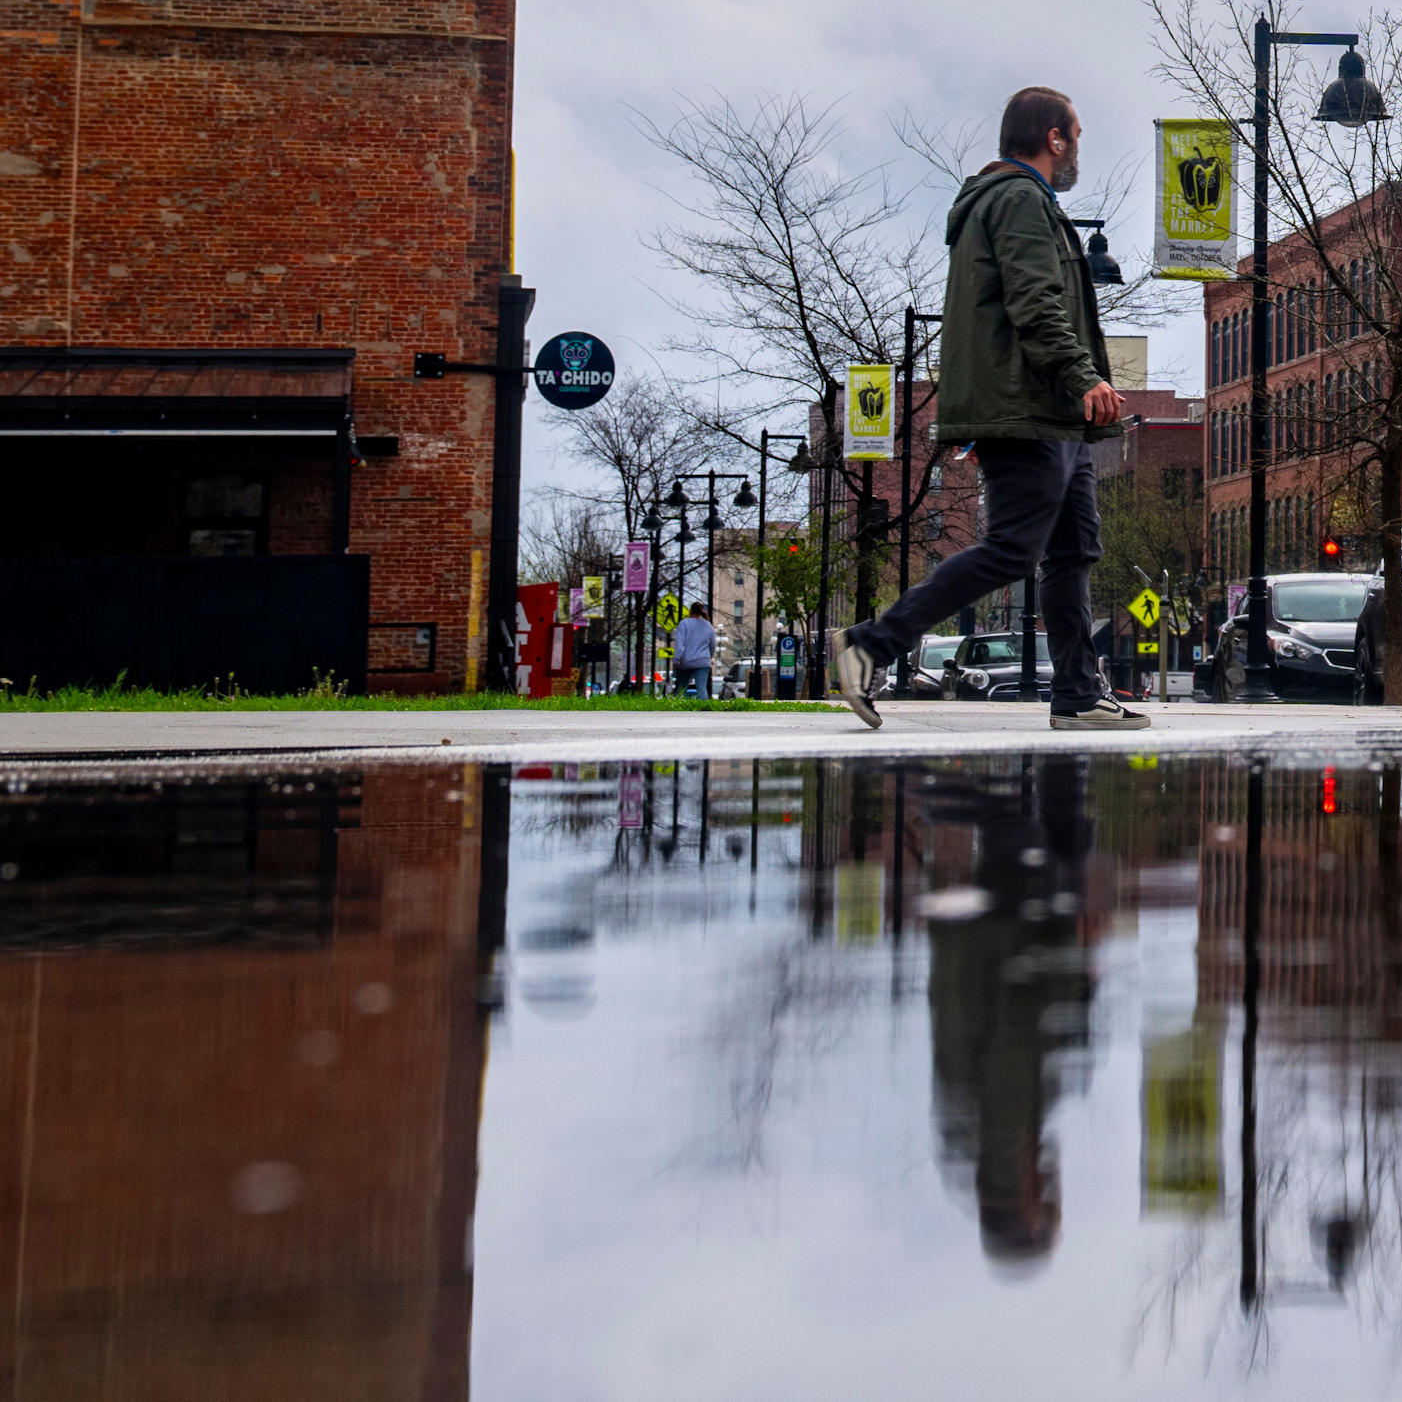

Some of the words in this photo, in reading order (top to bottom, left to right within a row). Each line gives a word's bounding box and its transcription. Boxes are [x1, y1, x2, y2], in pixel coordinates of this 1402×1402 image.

[1171, 134, 1197, 146] MEET
[1171, 147, 1185, 158] ME
[1171, 219, 1215, 233] MARKET
